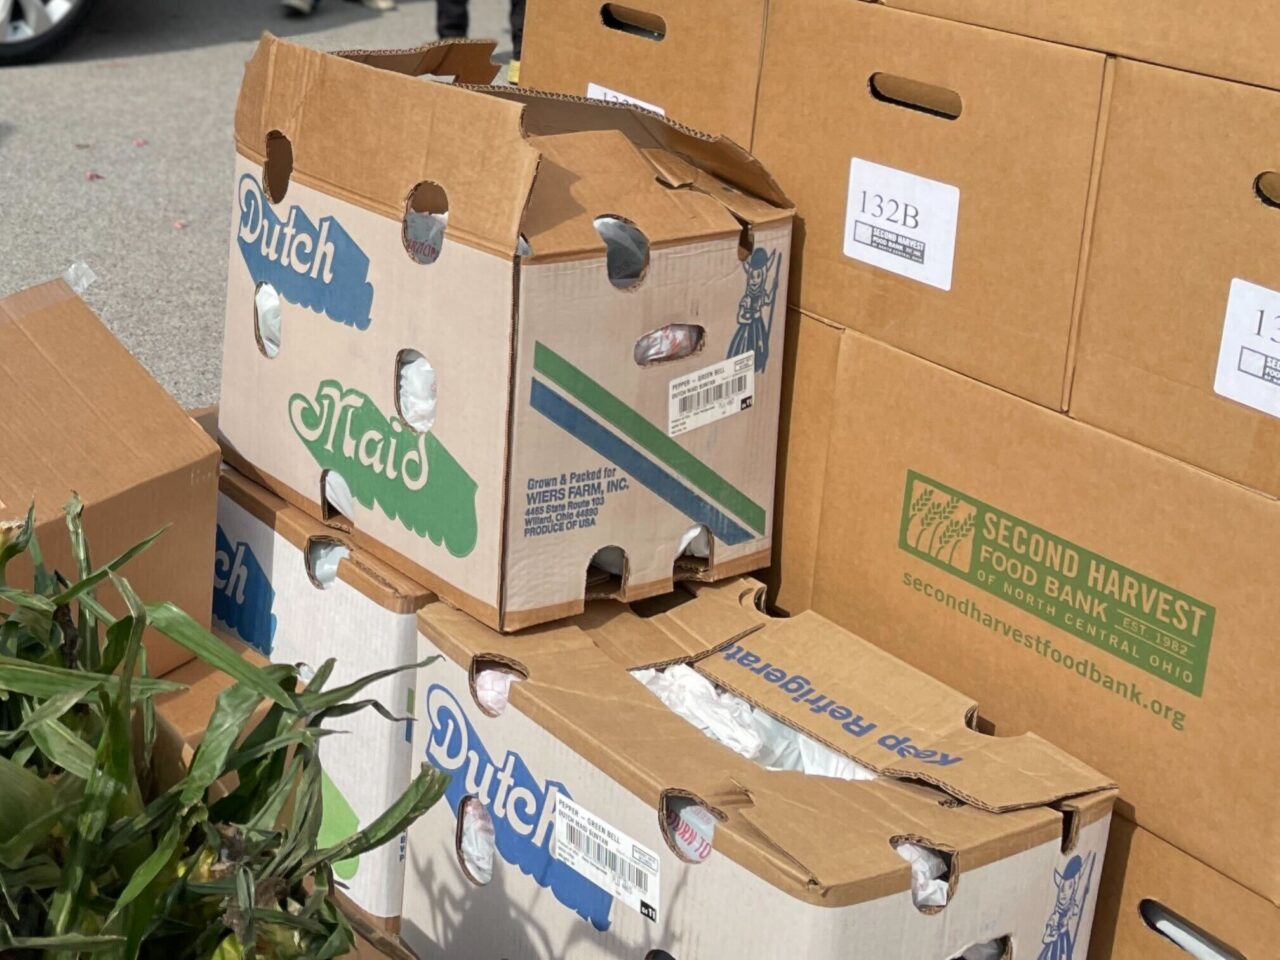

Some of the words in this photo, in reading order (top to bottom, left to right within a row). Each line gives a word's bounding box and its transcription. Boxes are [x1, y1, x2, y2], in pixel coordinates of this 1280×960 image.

[239, 177, 335, 284] Dutch
[860, 190, 919, 230] 132B
[873, 227, 897, 243] SECOND
[897, 234, 924, 251] HARVEST
[290, 387, 429, 491] Maid
[526, 487, 566, 506] WIERS
[568, 482, 605, 499] FARM,
[607, 477, 630, 493] INC.
[527, 477, 557, 490] Grown
[560, 473, 567, 485] &
[569, 467, 602, 484] Packed
[603, 467, 617, 479] for
[524, 522, 564, 538] PRODUCE
[565, 519, 578, 530] OF
[579, 517, 597, 529] USA
[546, 503, 566, 514] State
[567, 499, 590, 510] Route
[555, 511, 574, 522] Ohio
[981, 511, 1080, 579] SECOND
[1088, 559, 1207, 637] HARVEST
[979, 544, 1038, 587] FOOD
[1044, 577, 1110, 622] BANK
[1155, 632, 1188, 657] 1982
[977, 569, 996, 585] OF
[1003, 581, 1056, 617] NORTH
[1064, 613, 1140, 658] CENTRAL
[1149, 654, 1193, 684] OHIO
[903, 571, 1186, 732] secondharvestfoodbank.org
[720, 643, 877, 737] Refrigerat
[877, 733, 964, 767] Keep
[428, 689, 558, 860] Dutch
[558, 799, 579, 817] PEPPER
[587, 817, 606, 835] GREEN
[606, 829, 621, 845] BELL
